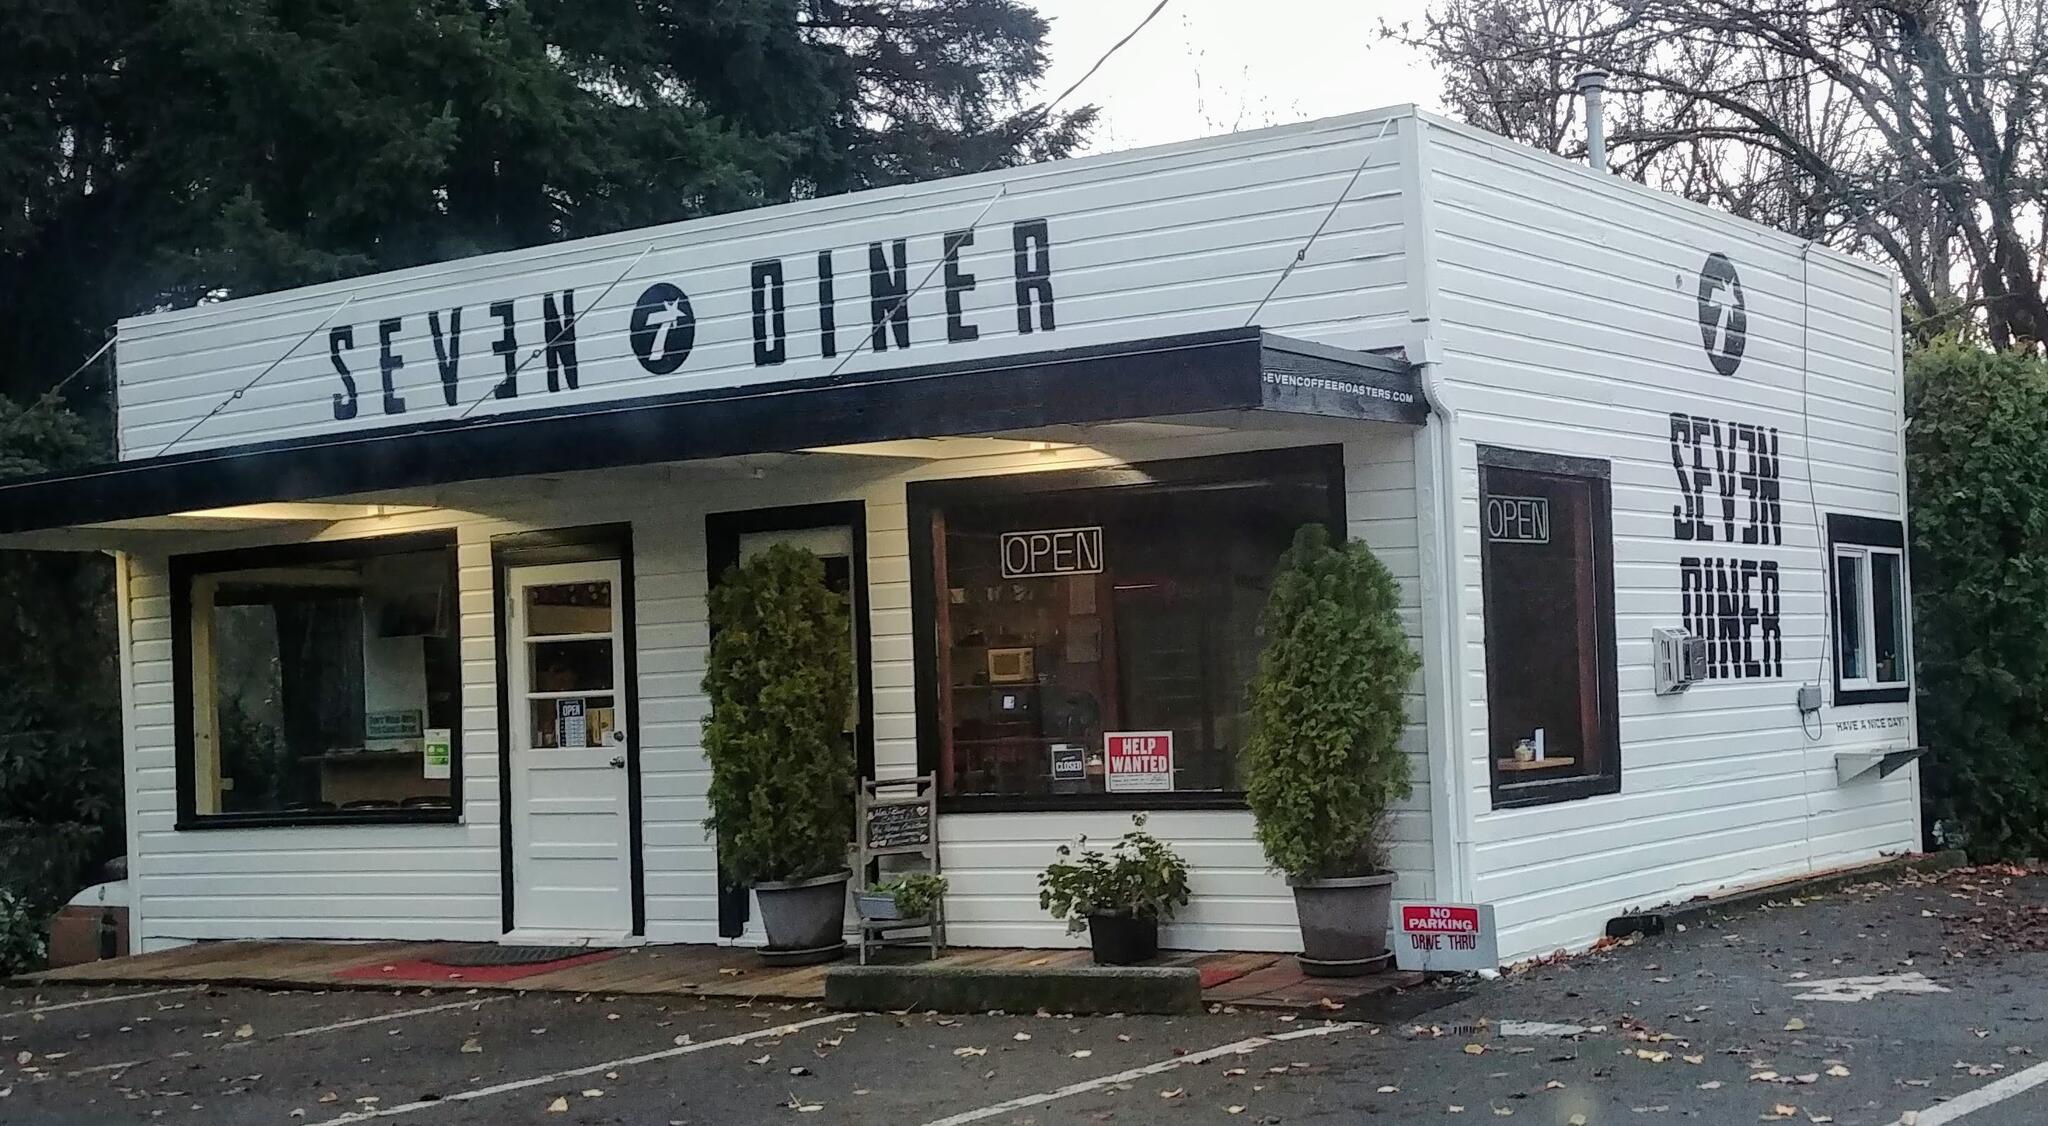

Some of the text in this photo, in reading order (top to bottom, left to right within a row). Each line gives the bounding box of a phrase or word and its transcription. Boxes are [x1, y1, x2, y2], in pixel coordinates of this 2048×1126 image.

[751, 219, 1055, 367] DINER
[1488, 499, 1546, 539] OPEN
[1006, 531, 1098, 574] OPEN
[562, 704, 580, 717] OPEN
[1836, 720, 1859, 732] HAVE
[1861, 719, 1867, 730] A
[1868, 717, 1886, 729] NICE
[1122, 737, 1157, 755] HELP
[1055, 760, 1083, 772] CLOSED
[1111, 755, 1168, 773] WANTED
[1429, 907, 1451, 919] NO
[1408, 918, 1473, 930] PARKING
[1411, 933, 1477, 950] DRIVE THRU
